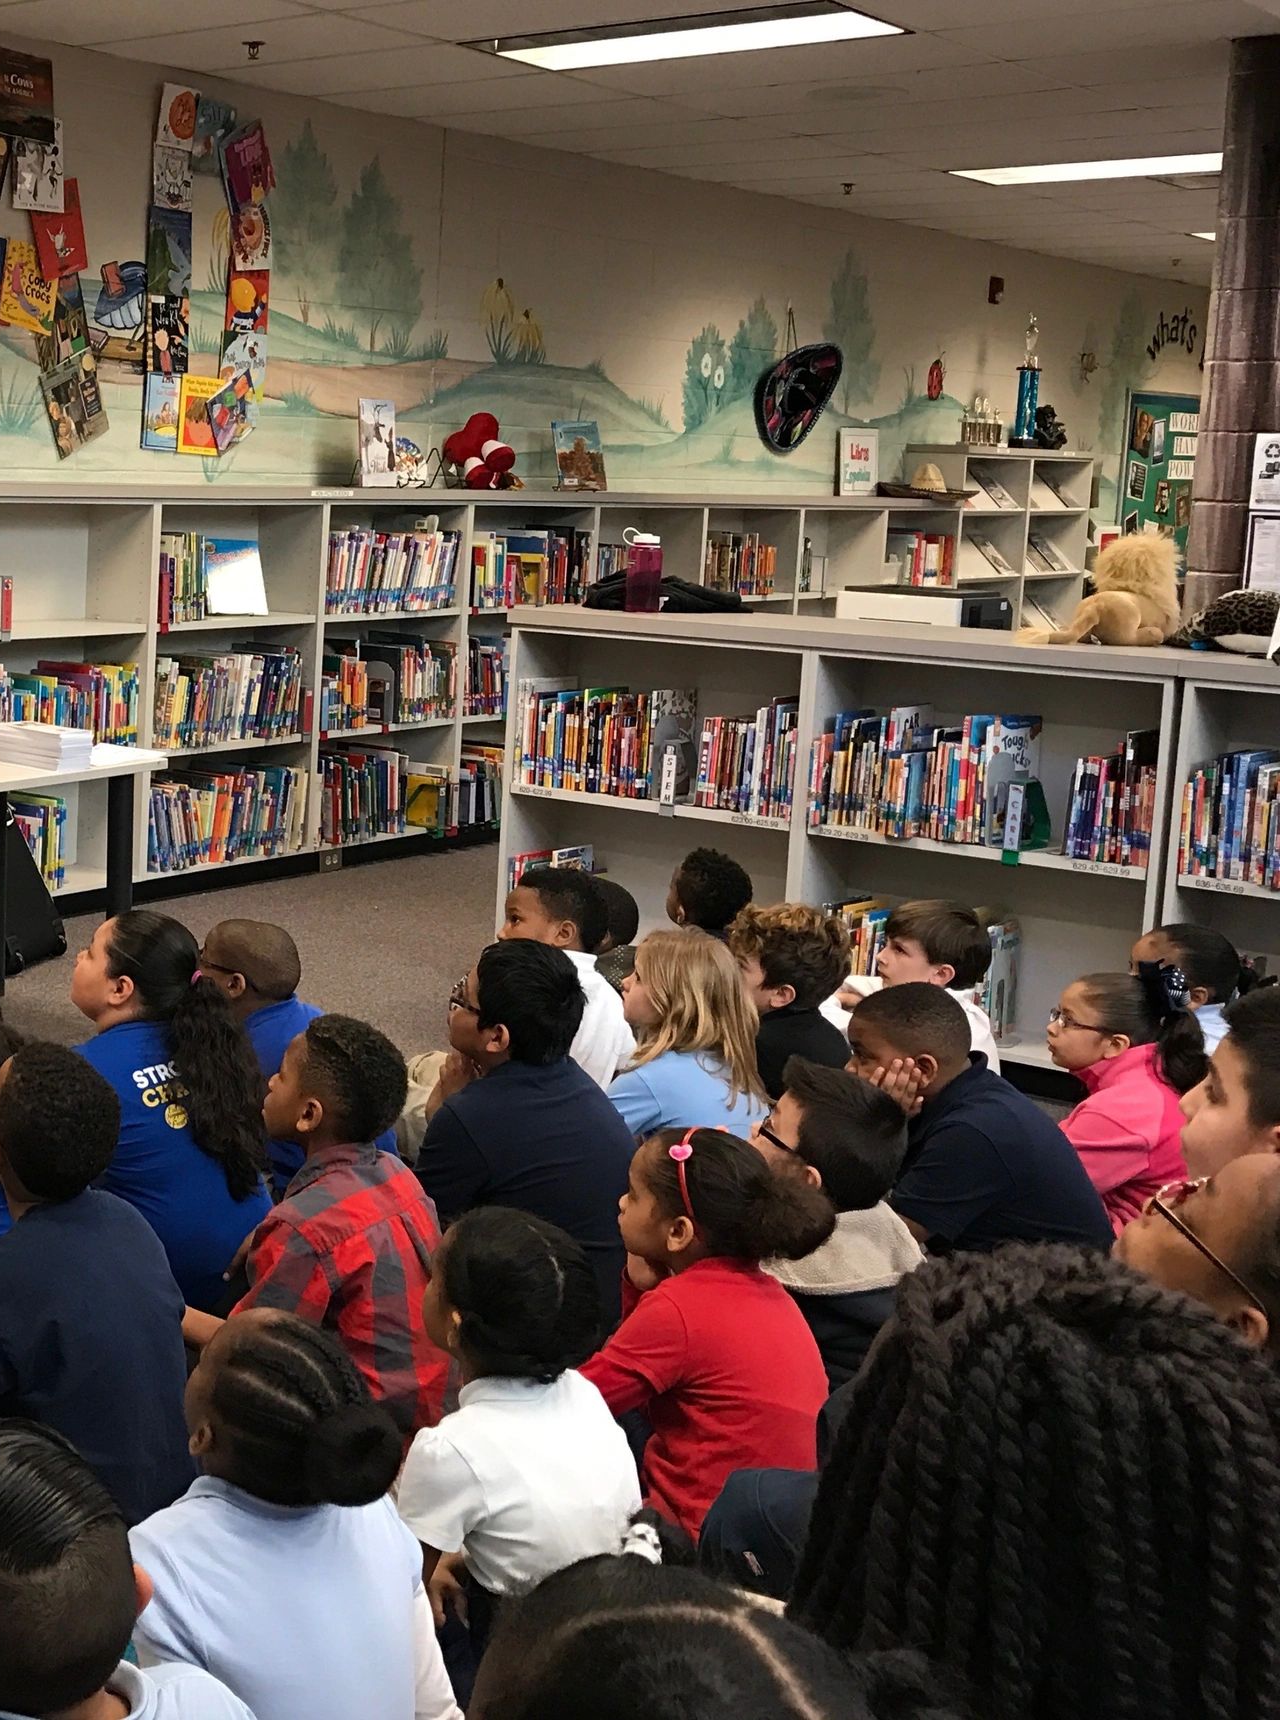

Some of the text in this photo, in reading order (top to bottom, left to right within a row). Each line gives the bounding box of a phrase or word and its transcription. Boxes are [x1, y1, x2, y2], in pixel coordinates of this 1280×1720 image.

[28, 273, 53, 293] Copy
[25, 285, 52, 305] Crocs
[1171, 413, 1200, 432] WOR
[1175, 437, 1198, 455] HAV
[1169, 460, 1194, 478] POW
[663, 756, 674, 803] STEM
[1008, 800, 1019, 846] CARS
